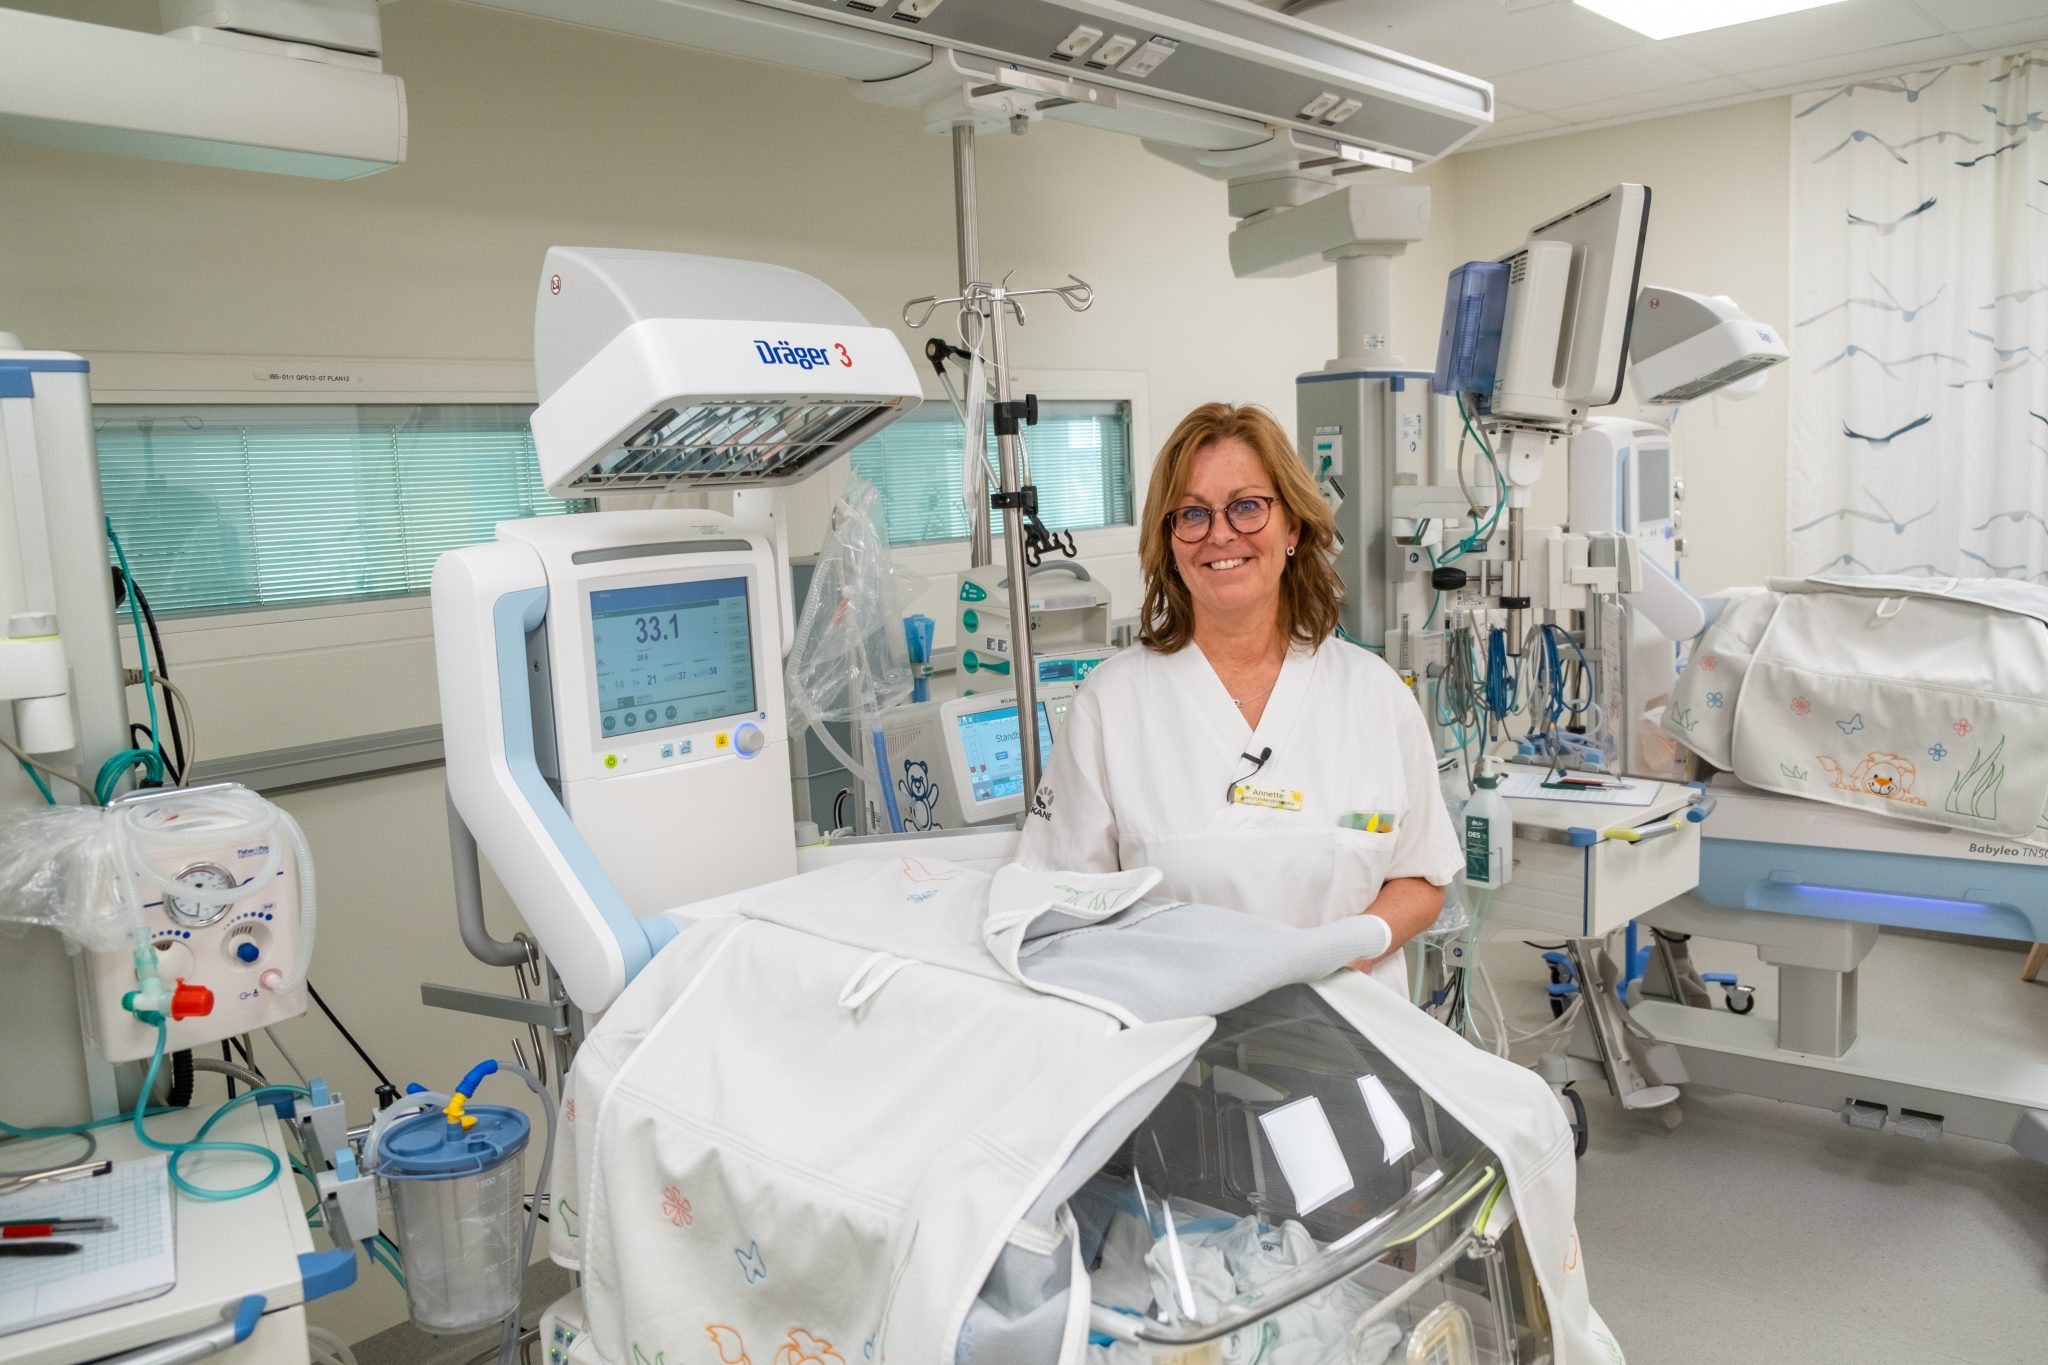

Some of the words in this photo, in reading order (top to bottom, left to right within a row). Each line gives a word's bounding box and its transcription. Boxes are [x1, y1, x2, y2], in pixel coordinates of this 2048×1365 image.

[753, 340, 830, 370] Dräger
[834, 342, 853, 368] 3
[635, 613, 679, 644] 33.1
[647, 673, 657, 686] 21
[1253, 789, 1284, 799] Annette
[1468, 831, 1481, 839] DES
[1968, 843, 2020, 857] Babyleo
